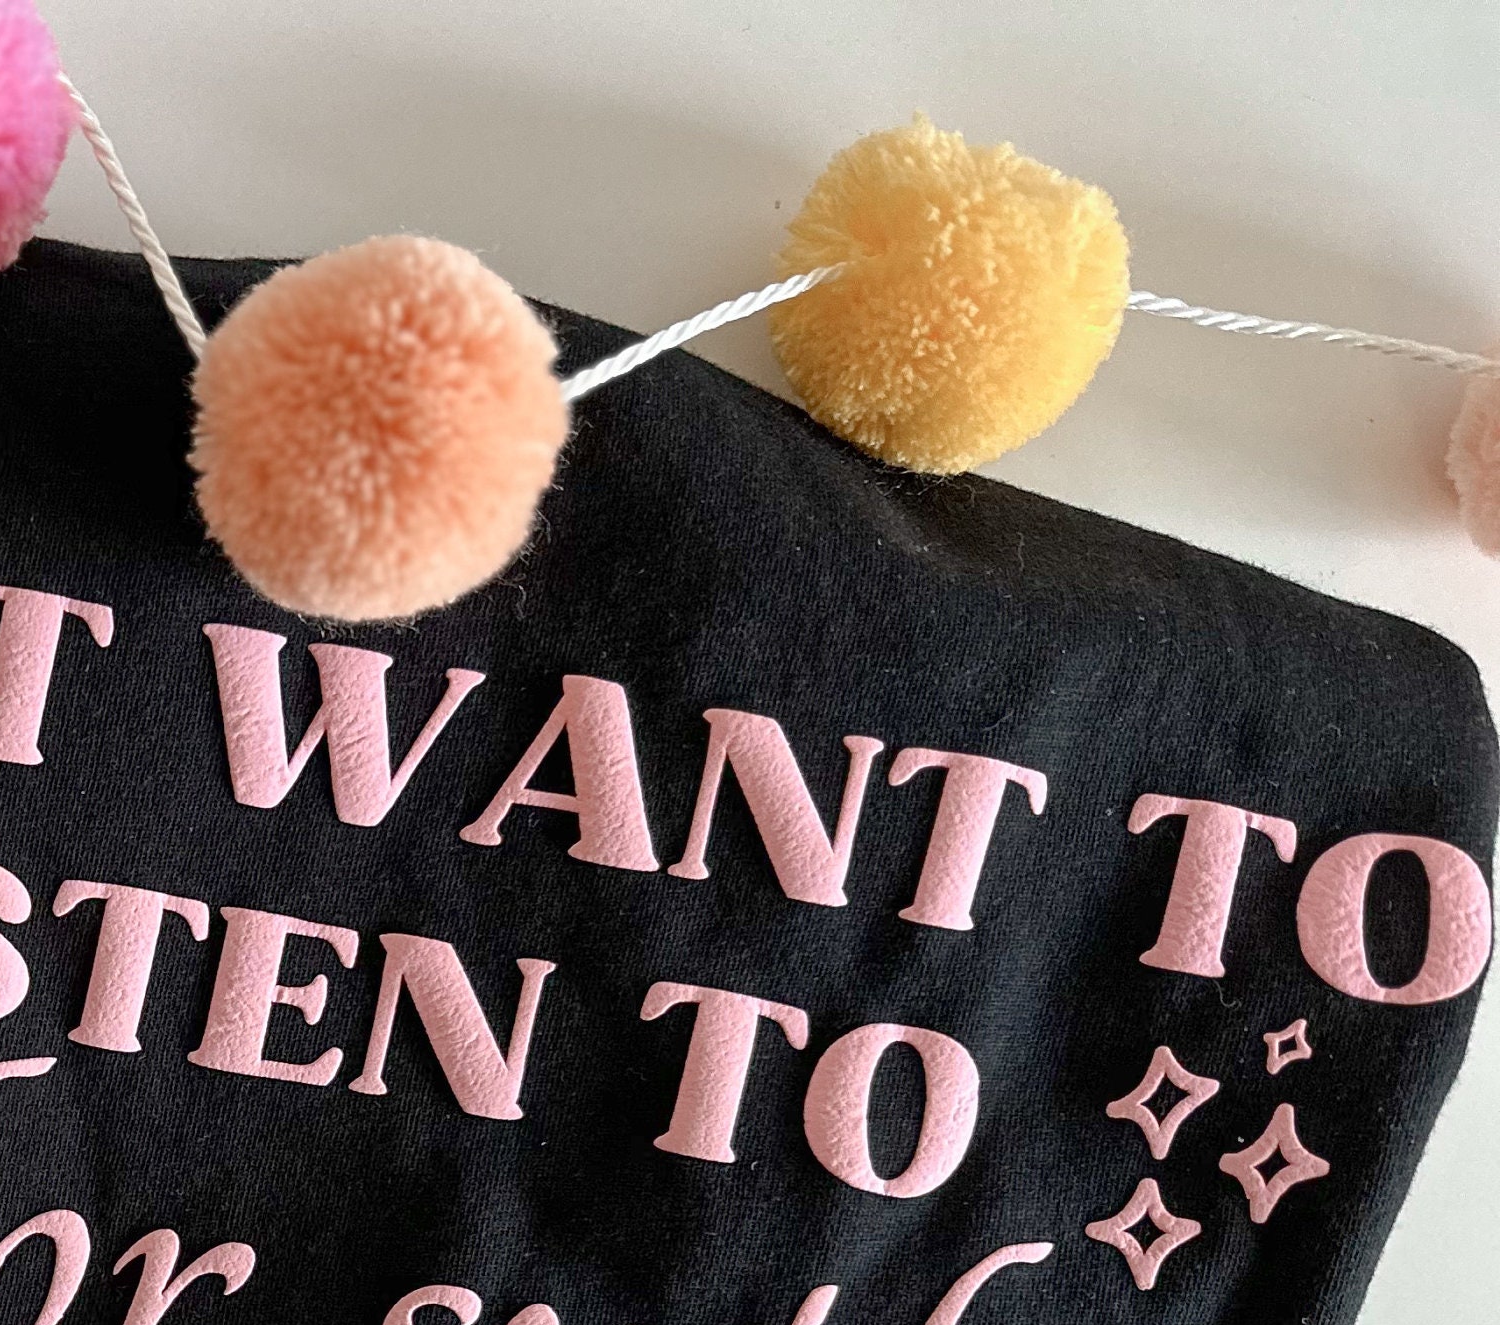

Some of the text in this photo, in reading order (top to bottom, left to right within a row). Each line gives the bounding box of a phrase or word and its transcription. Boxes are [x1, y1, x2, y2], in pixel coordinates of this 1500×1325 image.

[203, 623, 1049, 932] WANT
[1127, 793, 1493, 1005] TO
[640, 981, 981, 1199] TO
